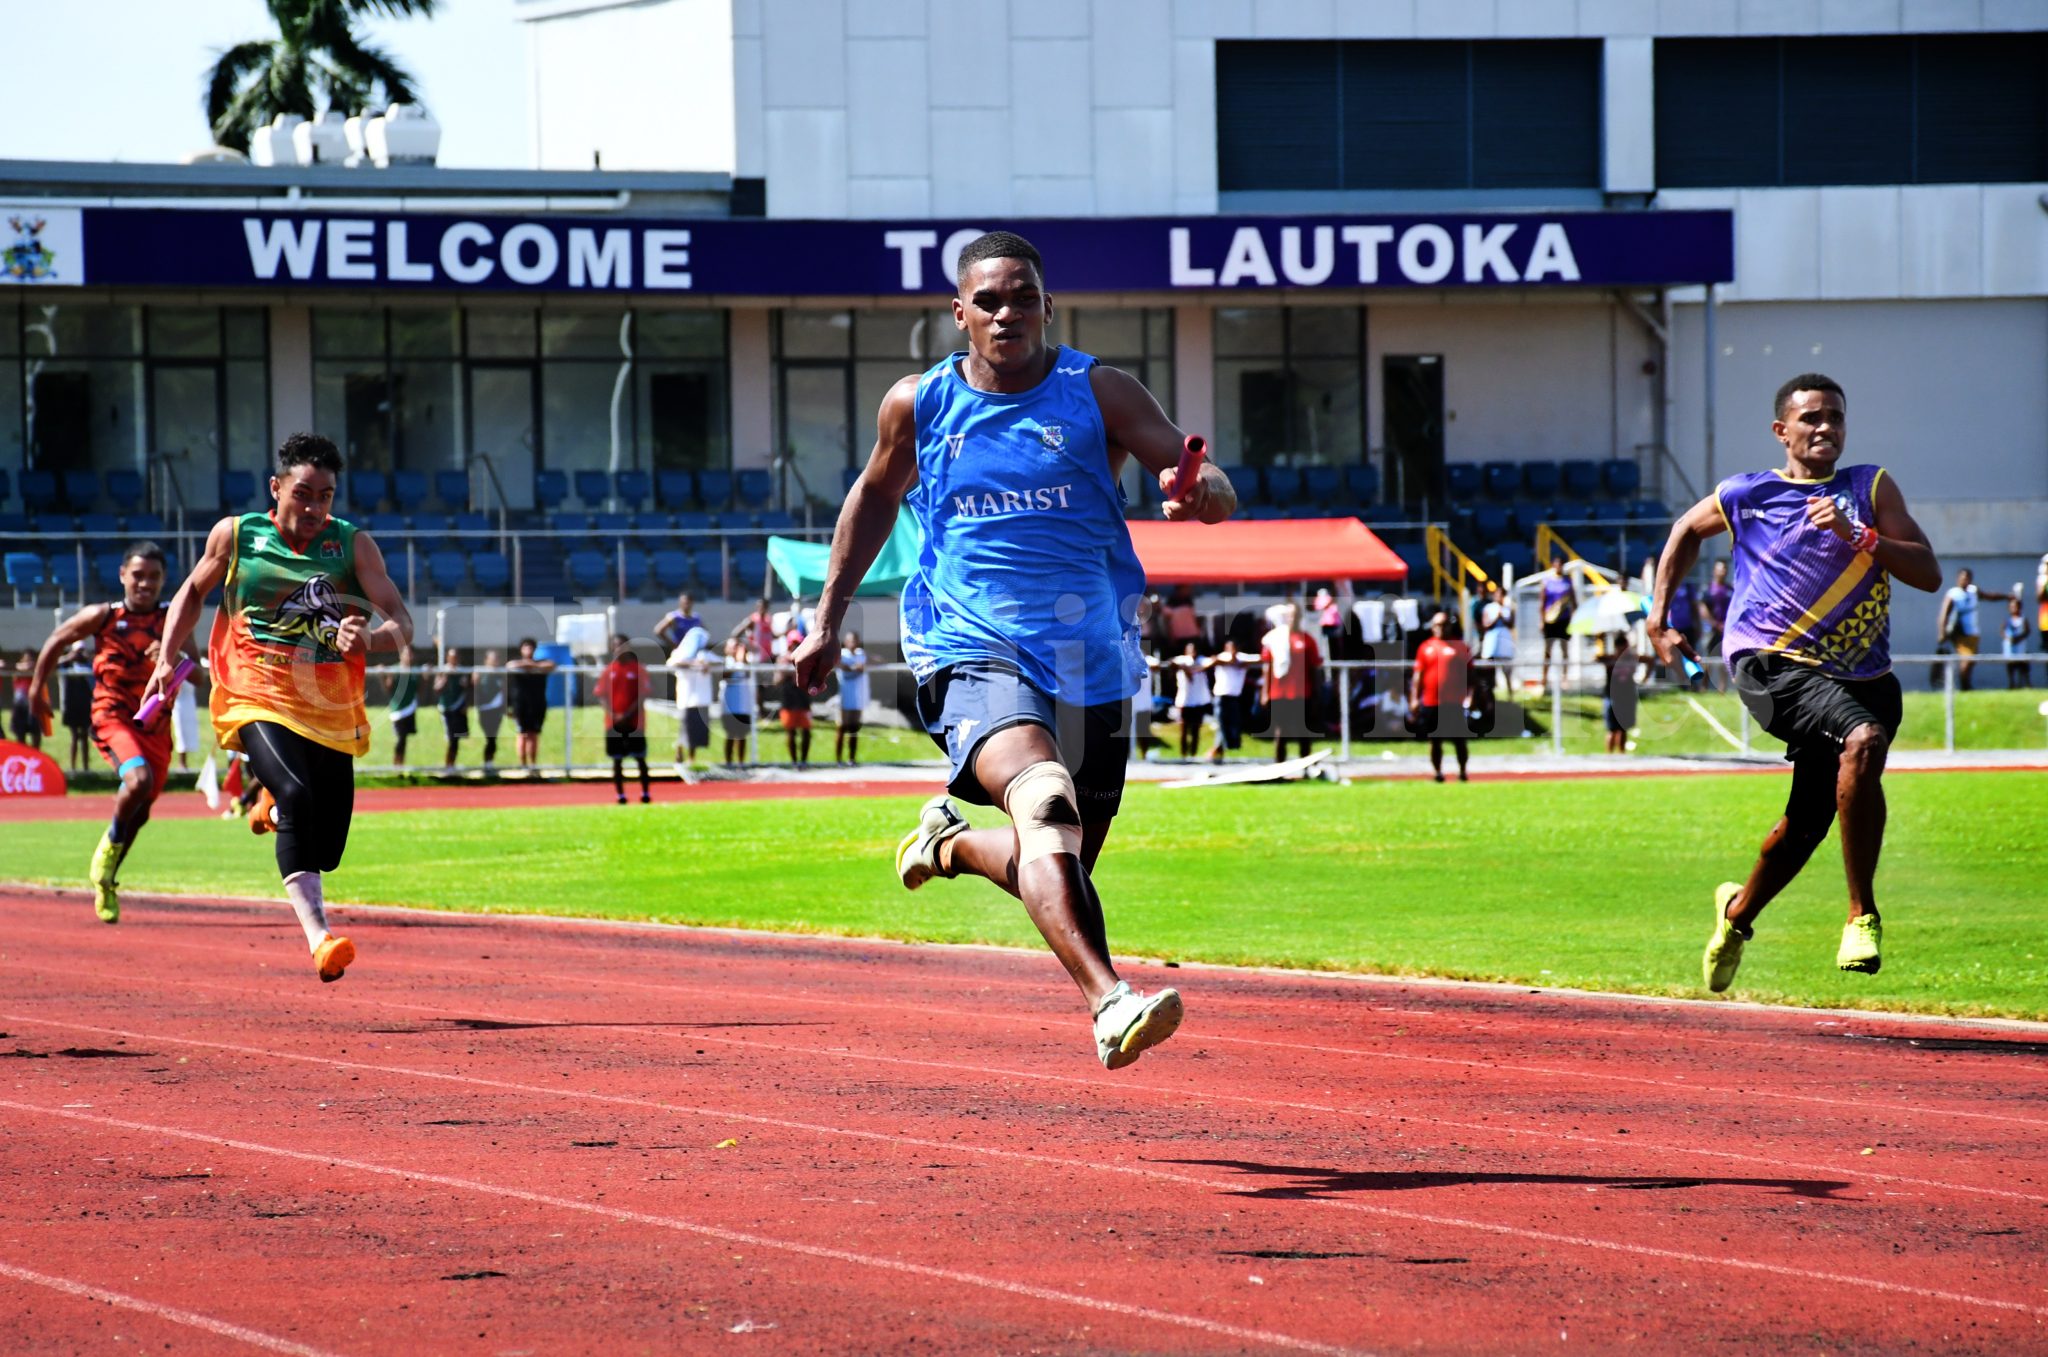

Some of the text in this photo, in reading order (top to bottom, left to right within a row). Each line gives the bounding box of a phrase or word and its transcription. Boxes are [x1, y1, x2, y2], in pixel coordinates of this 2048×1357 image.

[243, 219, 692, 288] WELCOME
[1170, 224, 1581, 286] LAUTOKA
[952, 484, 1072, 518] MARIST
